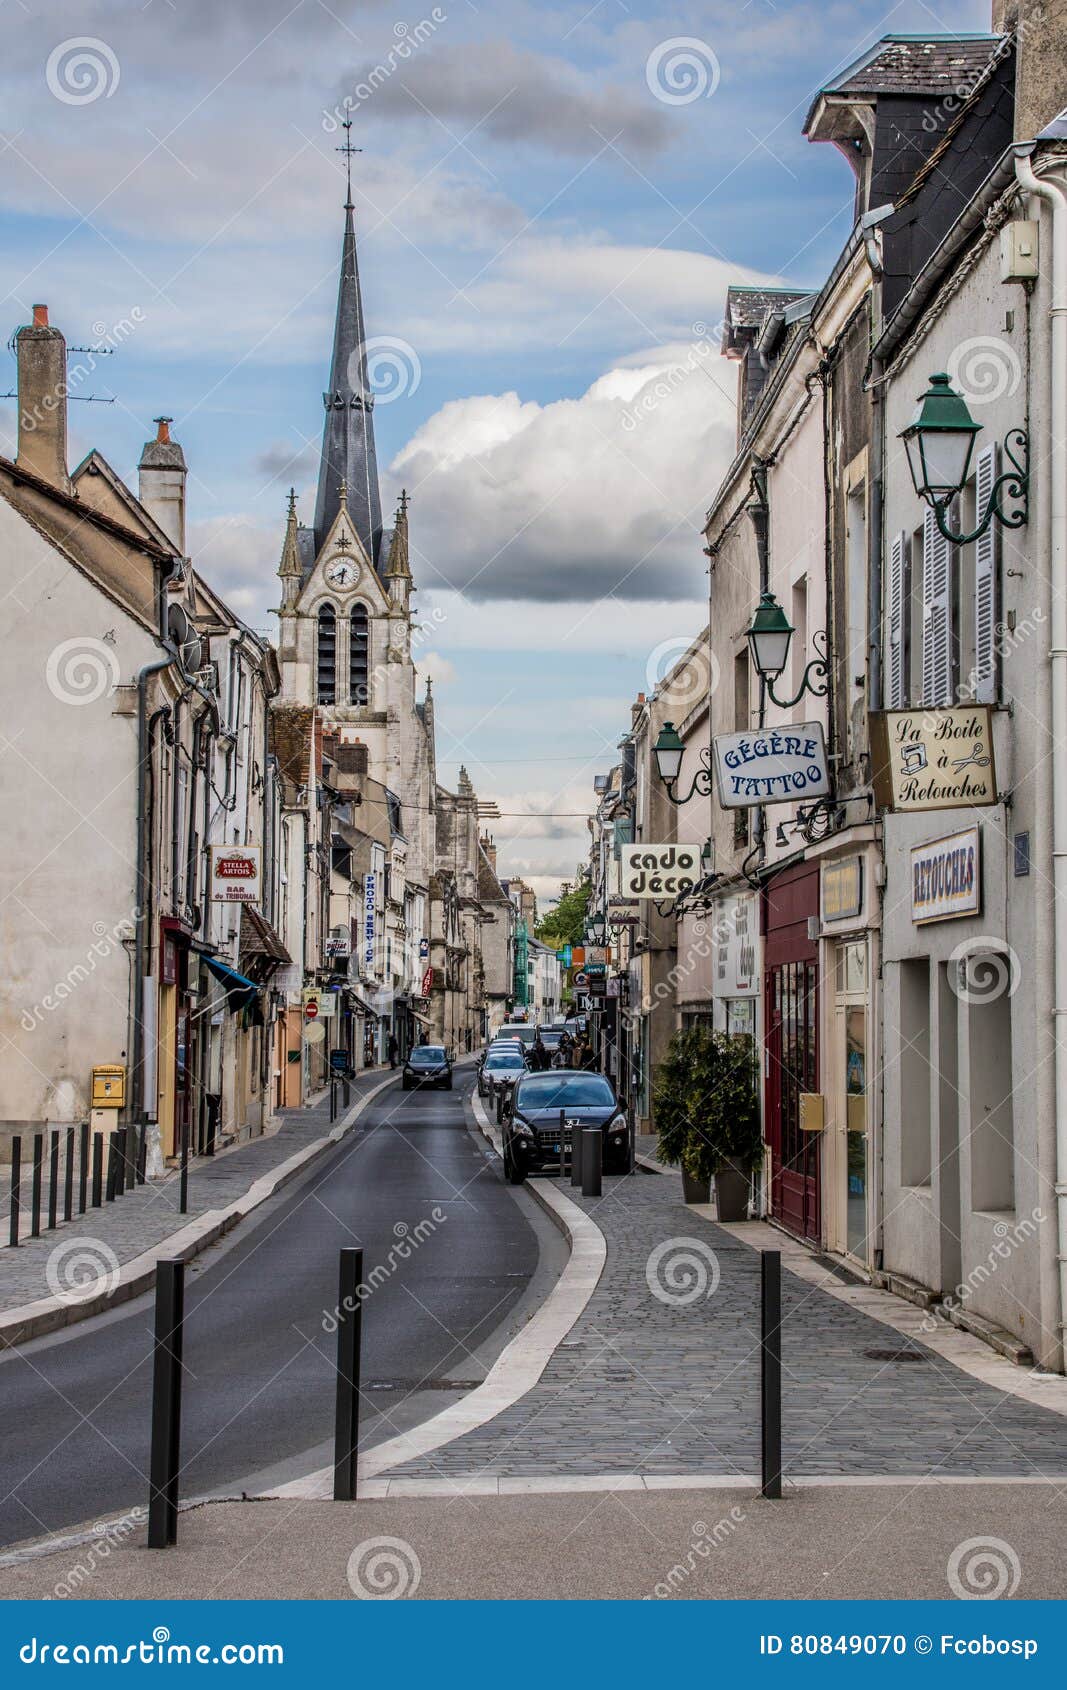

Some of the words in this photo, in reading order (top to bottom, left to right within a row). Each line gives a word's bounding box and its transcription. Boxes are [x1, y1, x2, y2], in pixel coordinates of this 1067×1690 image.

[895, 719, 921, 743] La
[724, 732, 818, 769] GÉGÈNE
[937, 749, 949, 768] à
[731, 765, 822, 796] TATTOO
[899, 774, 987, 801] Retouches
[630, 848, 693, 869] cado
[630, 871, 694, 893] déco
[913, 846, 974, 907] RETOUCHES
[366, 876, 375, 911] PHOTO
[366, 914, 375, 962] SERVICE
[421, 968, 433, 996] TABAC
